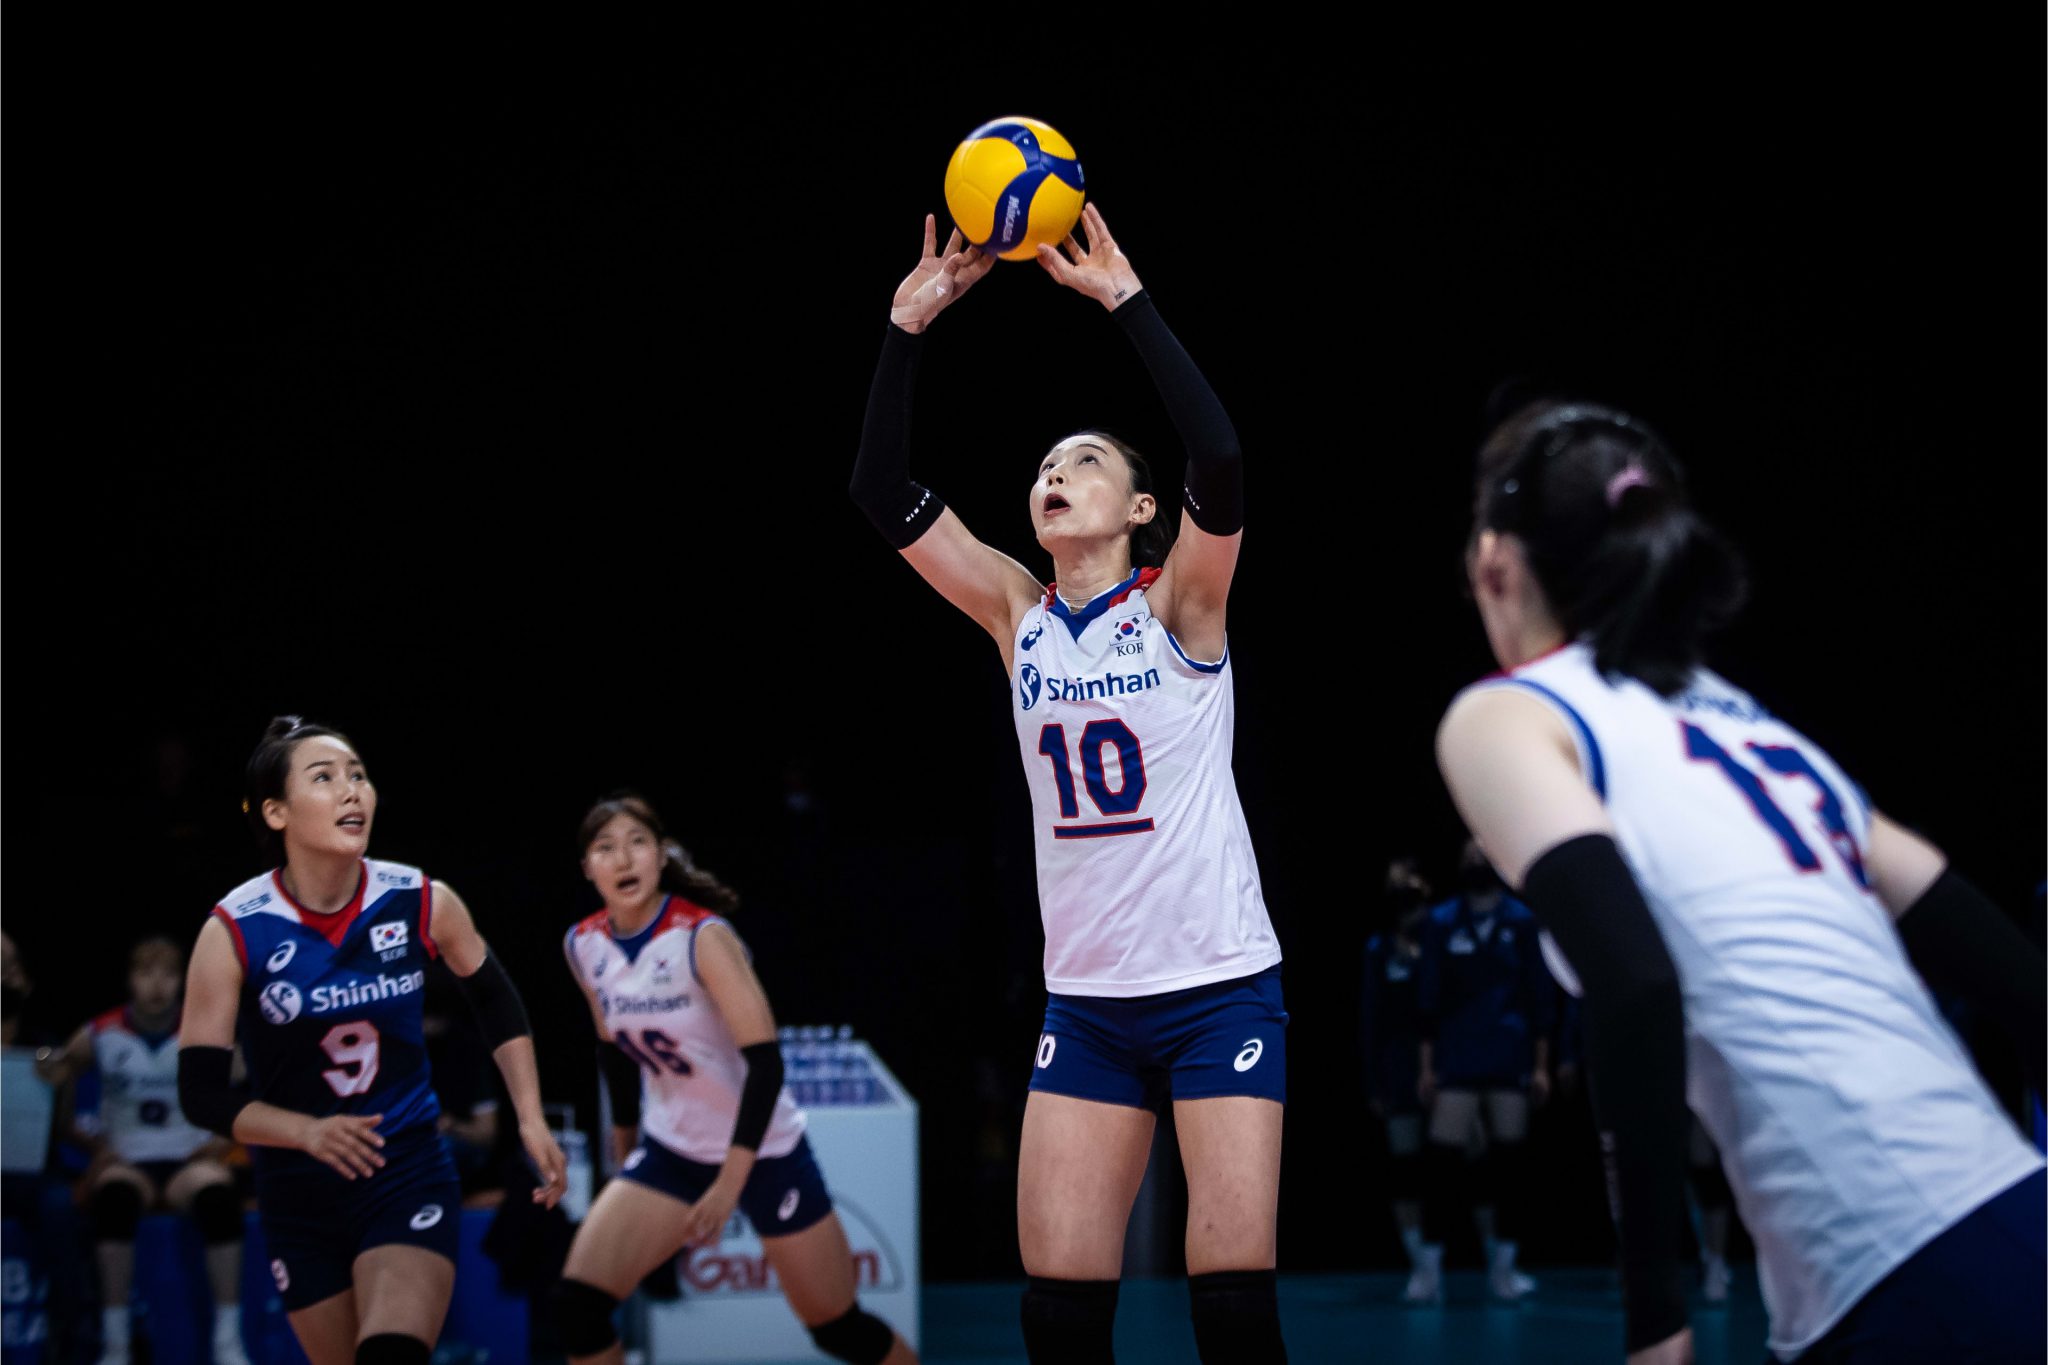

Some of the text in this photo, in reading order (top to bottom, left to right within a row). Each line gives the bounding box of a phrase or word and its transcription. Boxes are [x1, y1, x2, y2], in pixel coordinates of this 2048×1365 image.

[1046, 668, 1161, 702] Shinhan
[1038, 717, 1148, 819] 10
[310, 970, 424, 1013] Shinhan
[319, 1019, 381, 1098] 9
